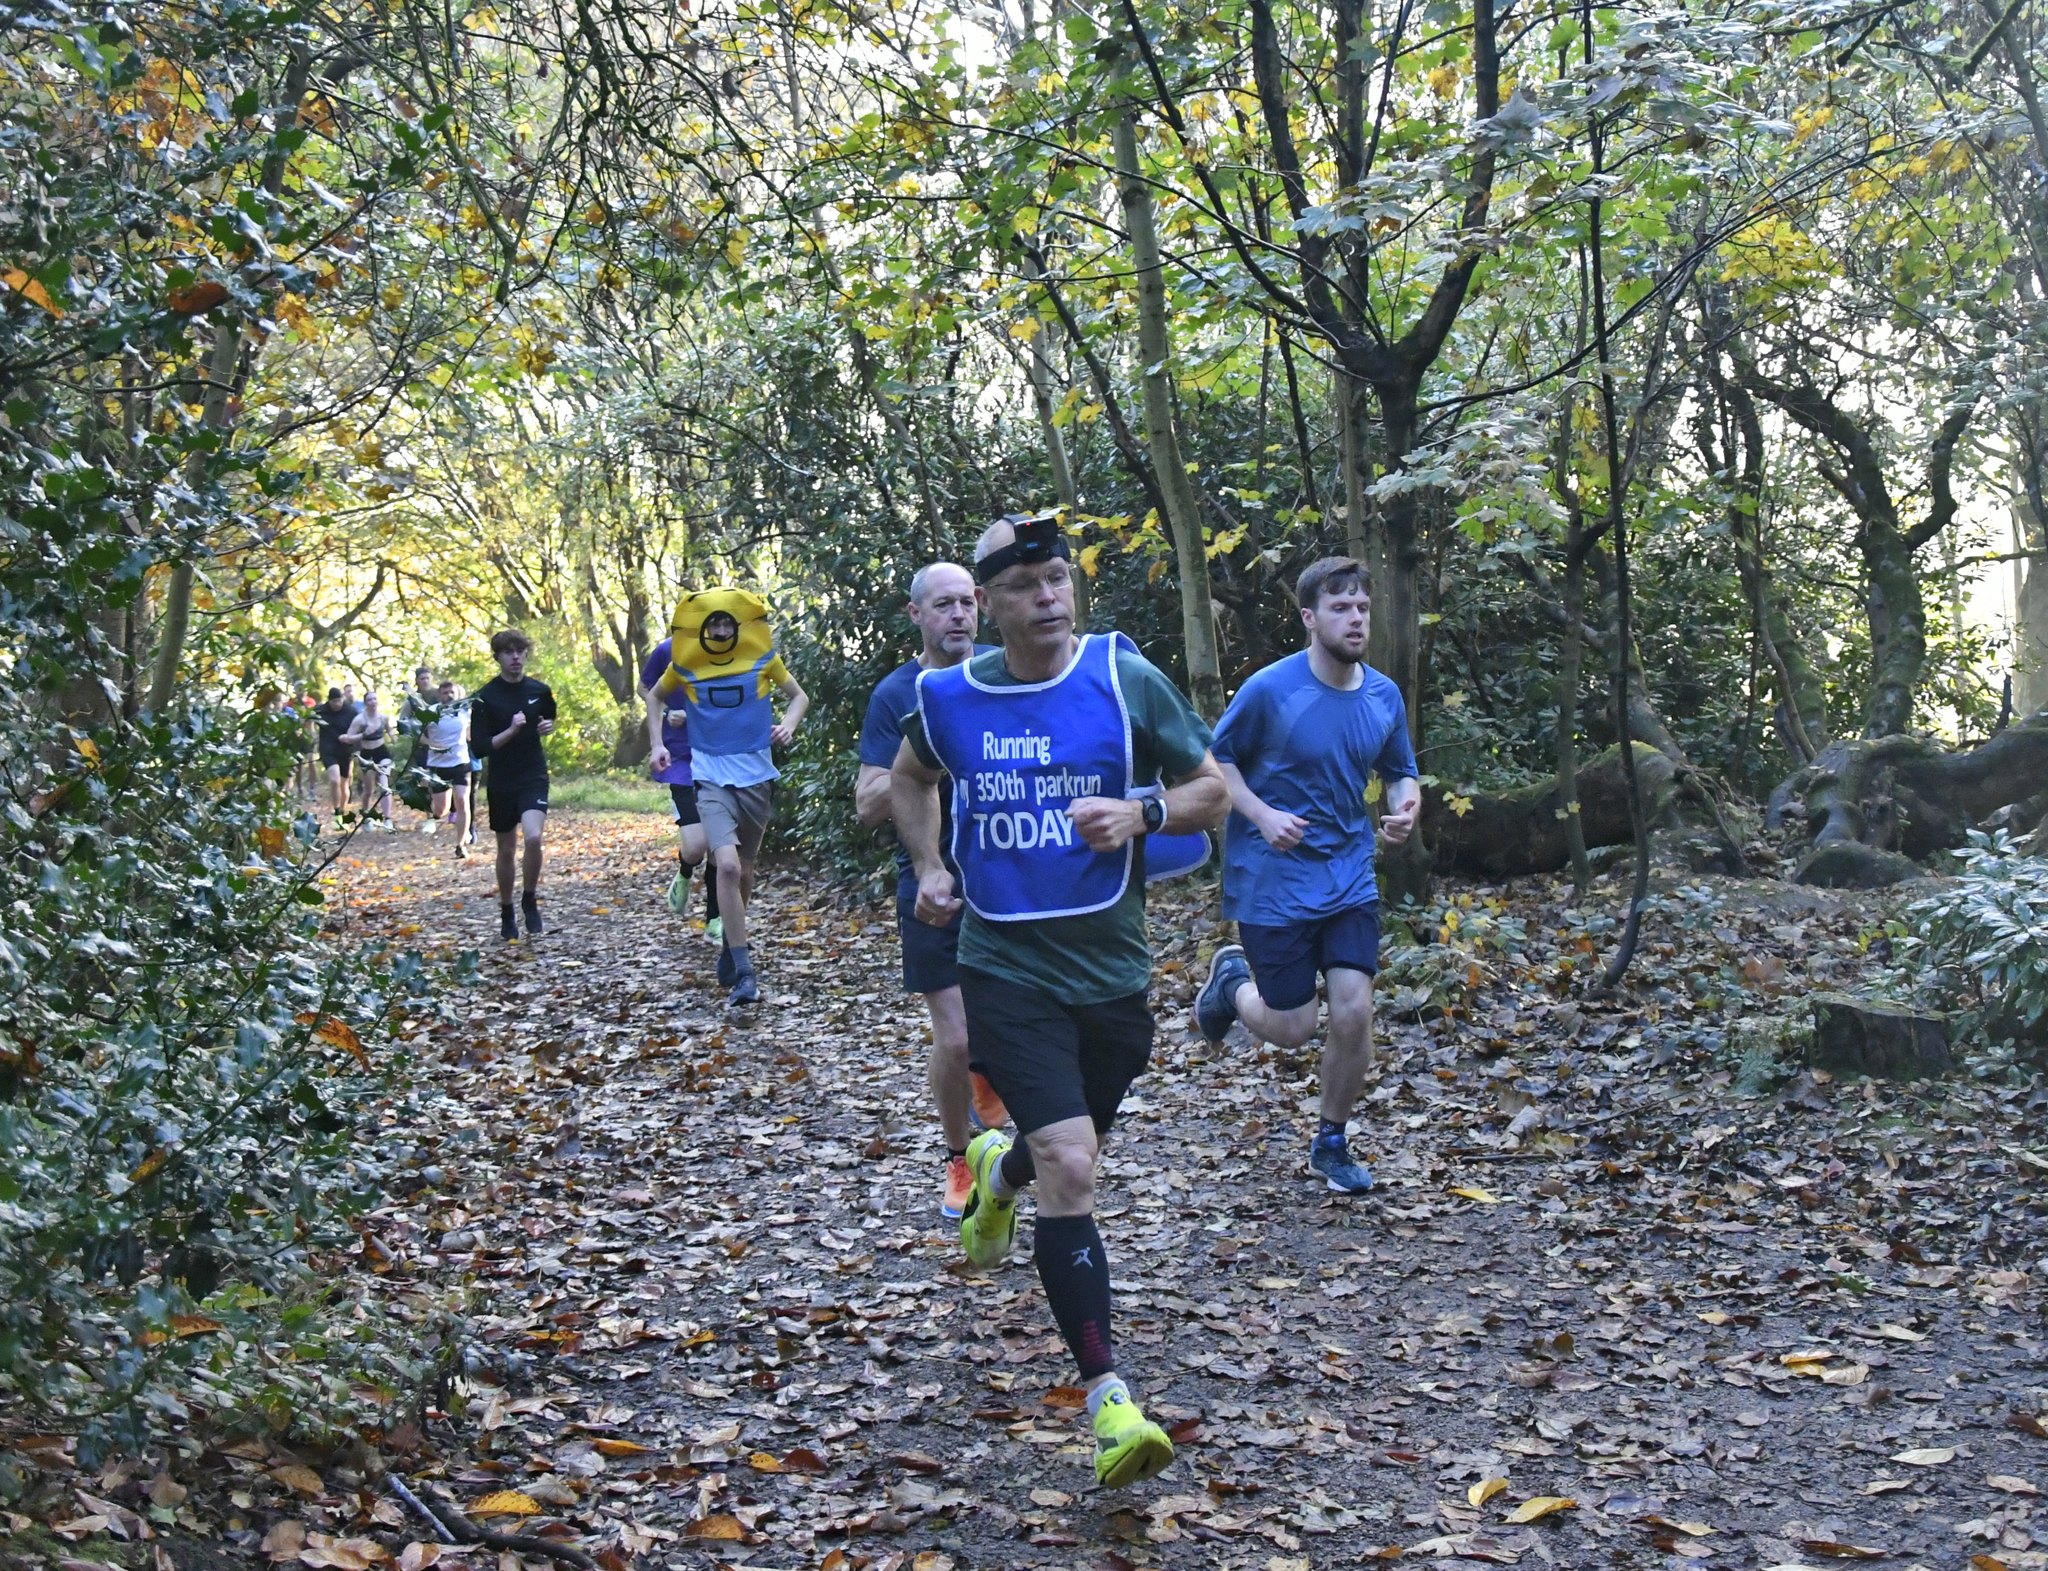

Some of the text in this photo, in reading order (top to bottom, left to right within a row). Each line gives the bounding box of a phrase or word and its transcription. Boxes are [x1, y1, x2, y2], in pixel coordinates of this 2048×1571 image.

[983, 728, 1051, 765] Running
[975, 769, 1026, 801] 350th
[1034, 767, 1101, 806] parkrun
[972, 809, 1074, 849] TODAY
